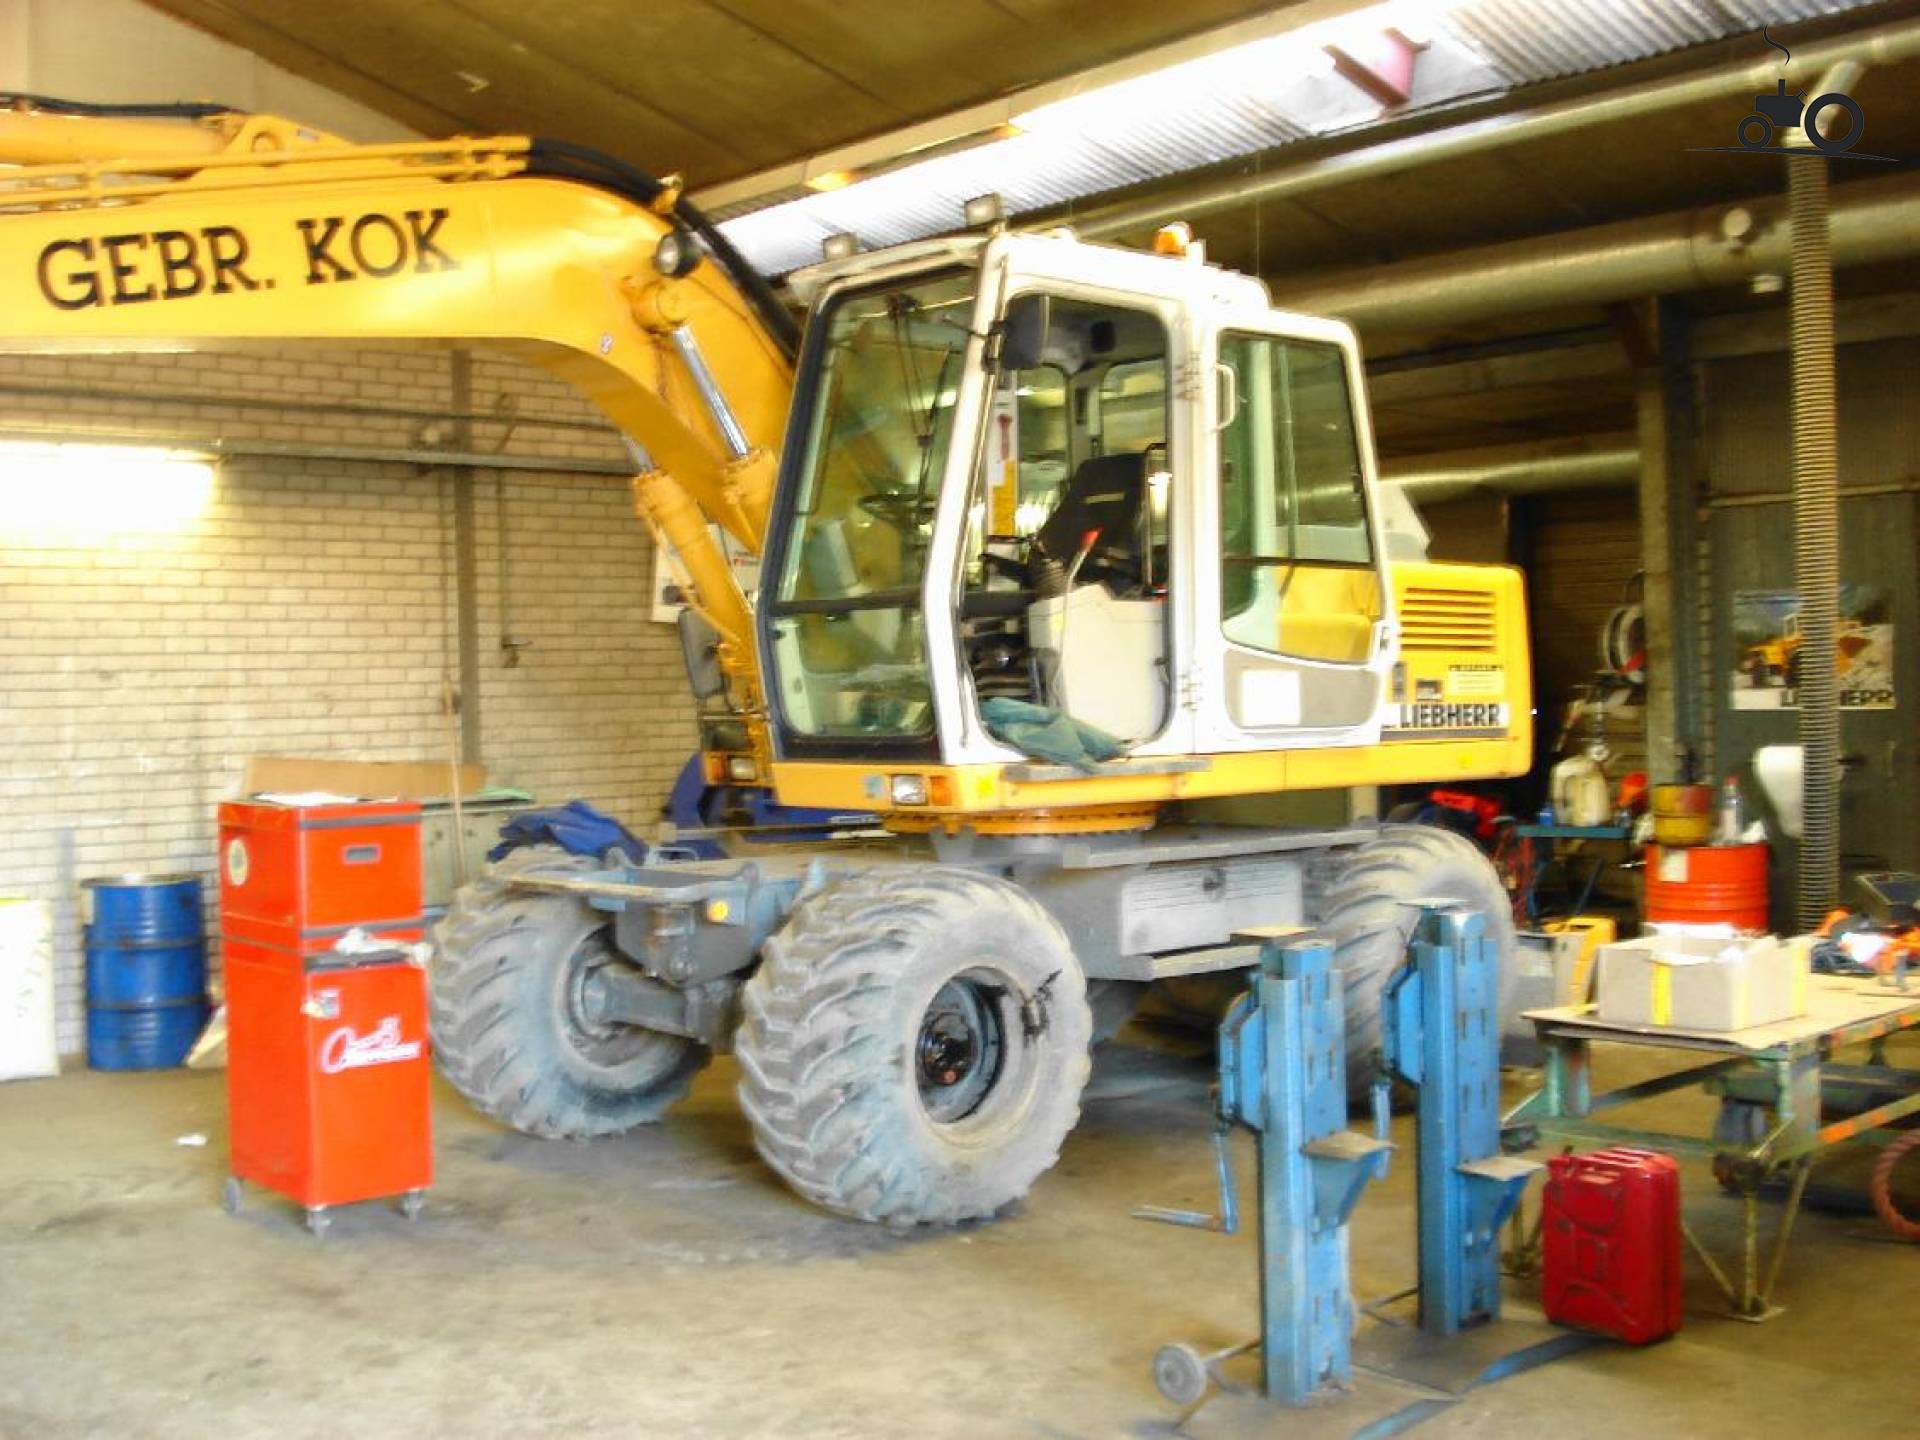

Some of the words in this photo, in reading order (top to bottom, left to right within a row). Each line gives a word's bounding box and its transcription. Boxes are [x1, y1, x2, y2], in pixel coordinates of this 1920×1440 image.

[37, 225, 276, 311] GEBR.
[296, 208, 461, 285] KOK
[1400, 703, 1500, 729] LIEBHERR
